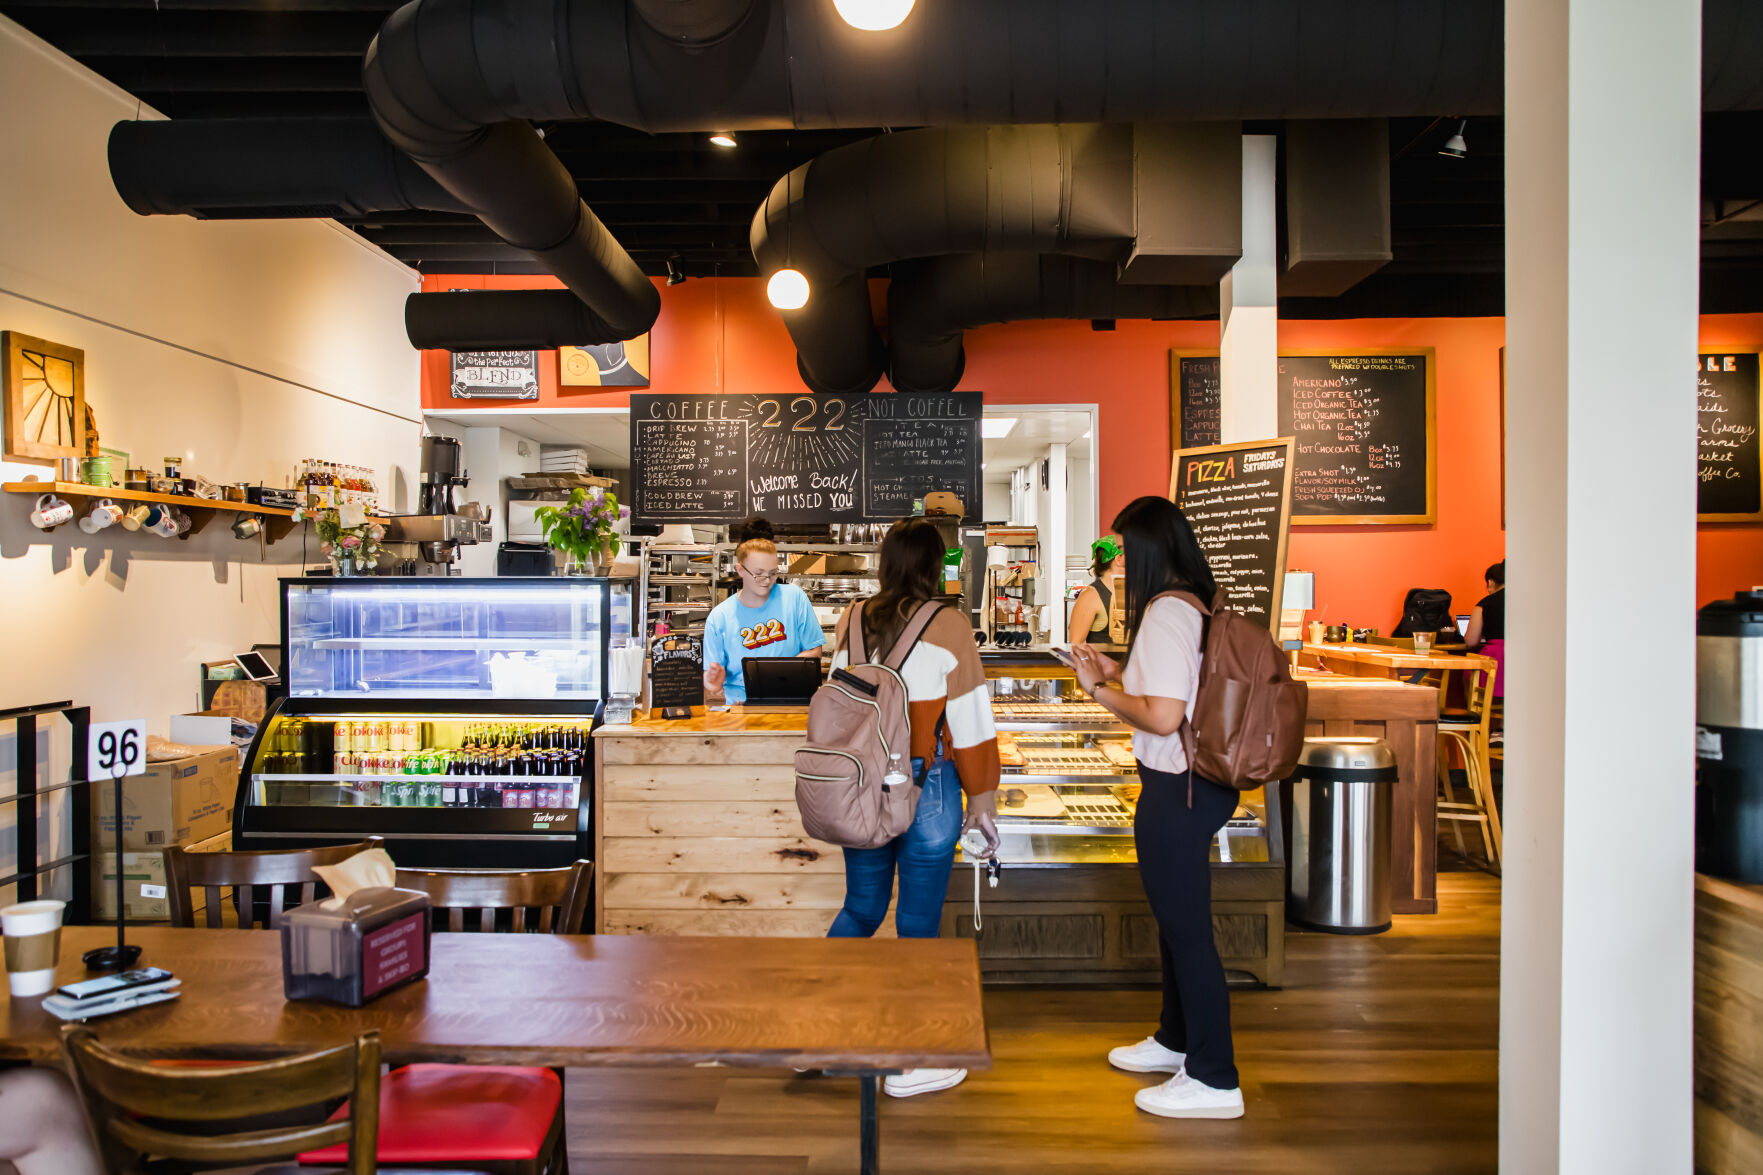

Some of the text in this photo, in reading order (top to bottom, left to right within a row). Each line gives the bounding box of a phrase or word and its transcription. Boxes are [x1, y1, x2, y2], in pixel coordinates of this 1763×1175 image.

[467, 368, 521, 384] BLEND
[1293, 376, 1341, 388] AMERICANO
[1294, 388, 1313, 399] ICED
[1315, 388, 1352, 399] COFFEE
[651, 401, 728, 419] COFFEE
[868, 399, 897, 418] NOT
[1294, 399, 1313, 409] ICED
[1314, 399, 1346, 409] ORGANIC
[1349, 399, 1363, 409] TEA
[758, 396, 845, 432] 222
[1294, 410, 1312, 420] HOT
[1313, 410, 1347, 420] ORGANIC
[1346, 409, 1362, 419] TEA
[1294, 421, 1315, 431] CHAI
[1318, 420, 1331, 431] TEA
[1186, 432, 1220, 441] LATTE
[893, 439, 914, 448] MANGO
[916, 439, 934, 447] BLACK
[937, 438, 948, 447] TEA
[1315, 442, 1361, 454] CHOCOLATE
[1244, 451, 1276, 464] FRIDAYS
[1698, 452, 1734, 461] asket
[1187, 457, 1235, 486] PIZZA
[1243, 458, 1285, 473] SATURDAYS
[1295, 468, 1317, 477] EXTRA
[1319, 468, 1339, 476] SHOT
[1698, 466, 1721, 482] offee
[751, 469, 858, 494] Welcome Back!
[753, 493, 853, 512] WE MISSED YOU
[741, 618, 787, 650] 222
[664, 650, 692, 659] FLAVORS
[98, 728, 139, 769] 96
[532, 812, 569, 822] Turbo air
